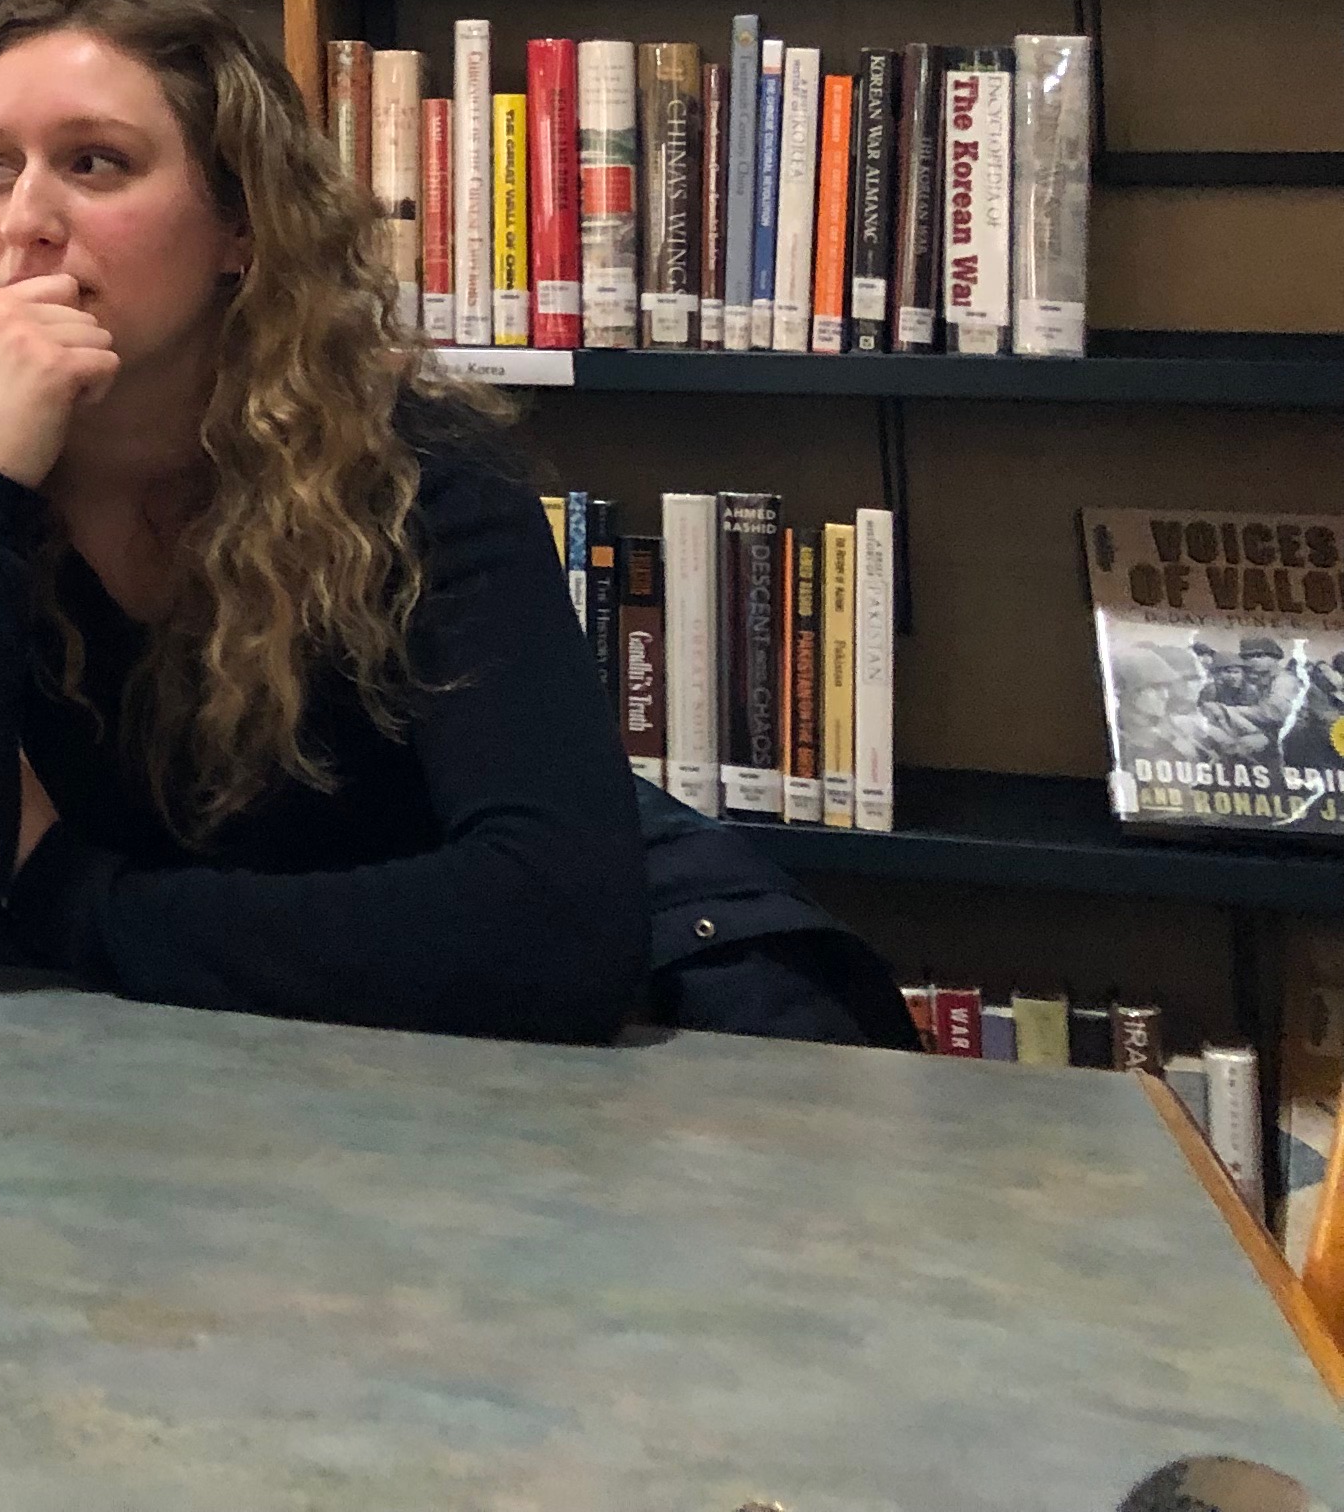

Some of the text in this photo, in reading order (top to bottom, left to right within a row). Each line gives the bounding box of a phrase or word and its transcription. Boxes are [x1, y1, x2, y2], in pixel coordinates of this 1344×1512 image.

[506, 109, 515, 250] THE GREAT WALL OF
[666, 99, 688, 201] CHINA'S
[734, 111, 751, 196] Century China
[862, 54, 886, 244] KOREAN WAR ALMANAC
[917, 137, 933, 222] THE KOREAN
[951, 76, 979, 246] The Korean
[986, 76, 1005, 202] ENCYCLOPEDIA
[467, 363, 506, 376] Korea
[724, 509, 777, 520] AHMED
[1149, 520, 1338, 568] VOICES
[1128, 562, 1191, 608] OF
[749, 544, 772, 767] DESCENT CHAOS
[834, 639, 846, 688] Pakistan
[867, 586, 882, 682] PAKISTAN
[628, 630, 654, 732] Gandhi's Truth
[1135, 758, 1271, 789] DOUGLAS
[948, 1007, 971, 1051] WAR
